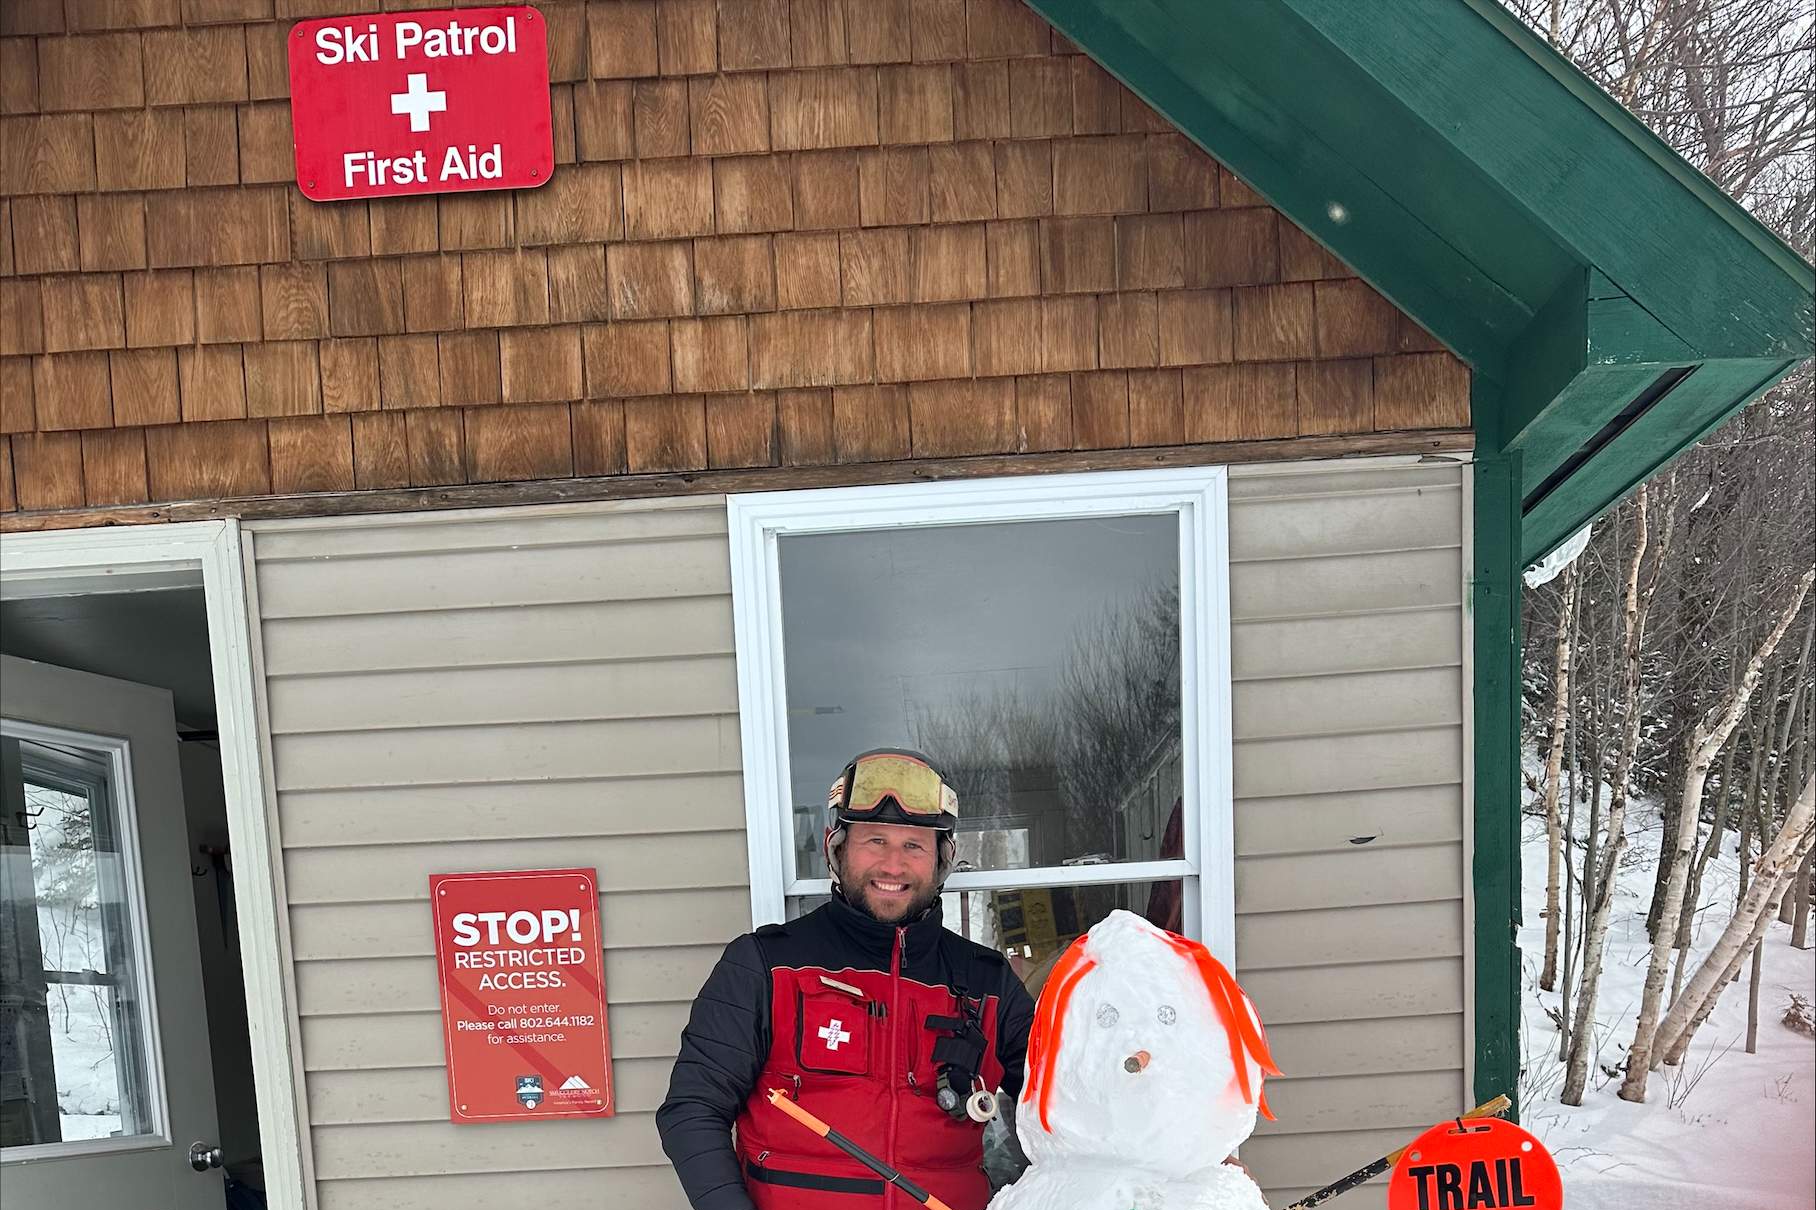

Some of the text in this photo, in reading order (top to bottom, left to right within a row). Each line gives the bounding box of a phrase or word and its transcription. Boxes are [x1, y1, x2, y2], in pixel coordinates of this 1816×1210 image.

[315, 16, 517, 65] Ski Patrol
[343, 143, 503, 188] First Aid
[452, 908, 583, 947] STOP!
[455, 947, 586, 969] RESTRICTED
[479, 971, 567, 990] ACCESS.
[488, 1003, 562, 1016] Do not enter.
[457, 1015, 595, 1031] Please call 802.644.1182
[487, 1032, 567, 1045] for assistance.
